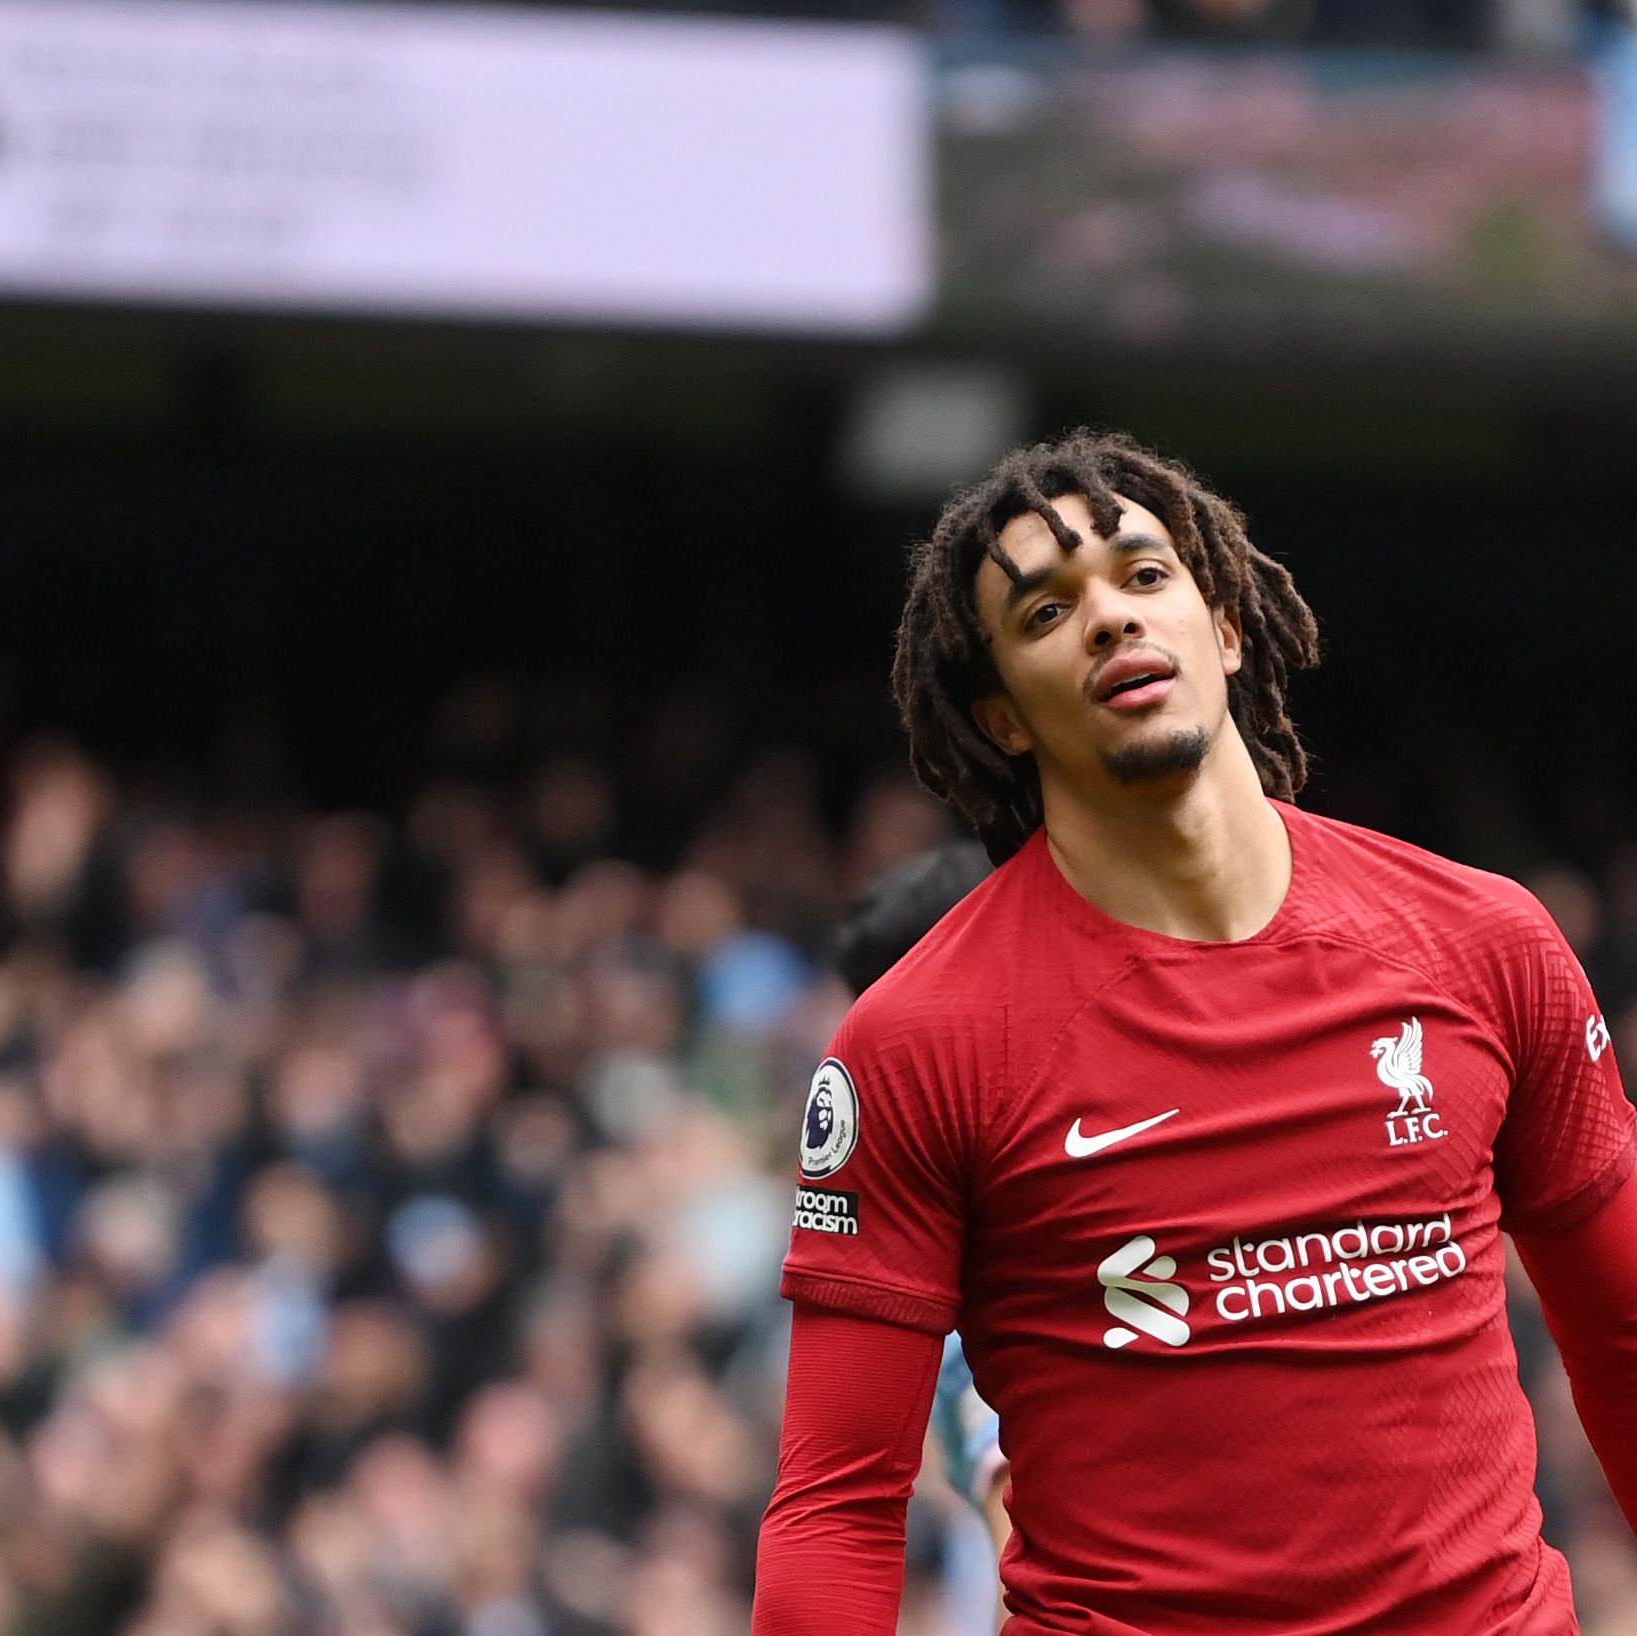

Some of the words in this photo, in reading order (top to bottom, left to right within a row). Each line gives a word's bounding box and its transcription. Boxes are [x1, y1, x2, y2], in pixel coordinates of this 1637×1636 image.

[808, 1151, 832, 1166] Premier
[830, 1119, 847, 1154] League
[1206, 1212, 1453, 1282] standard
[1215, 1240, 1467, 1321] chartered
